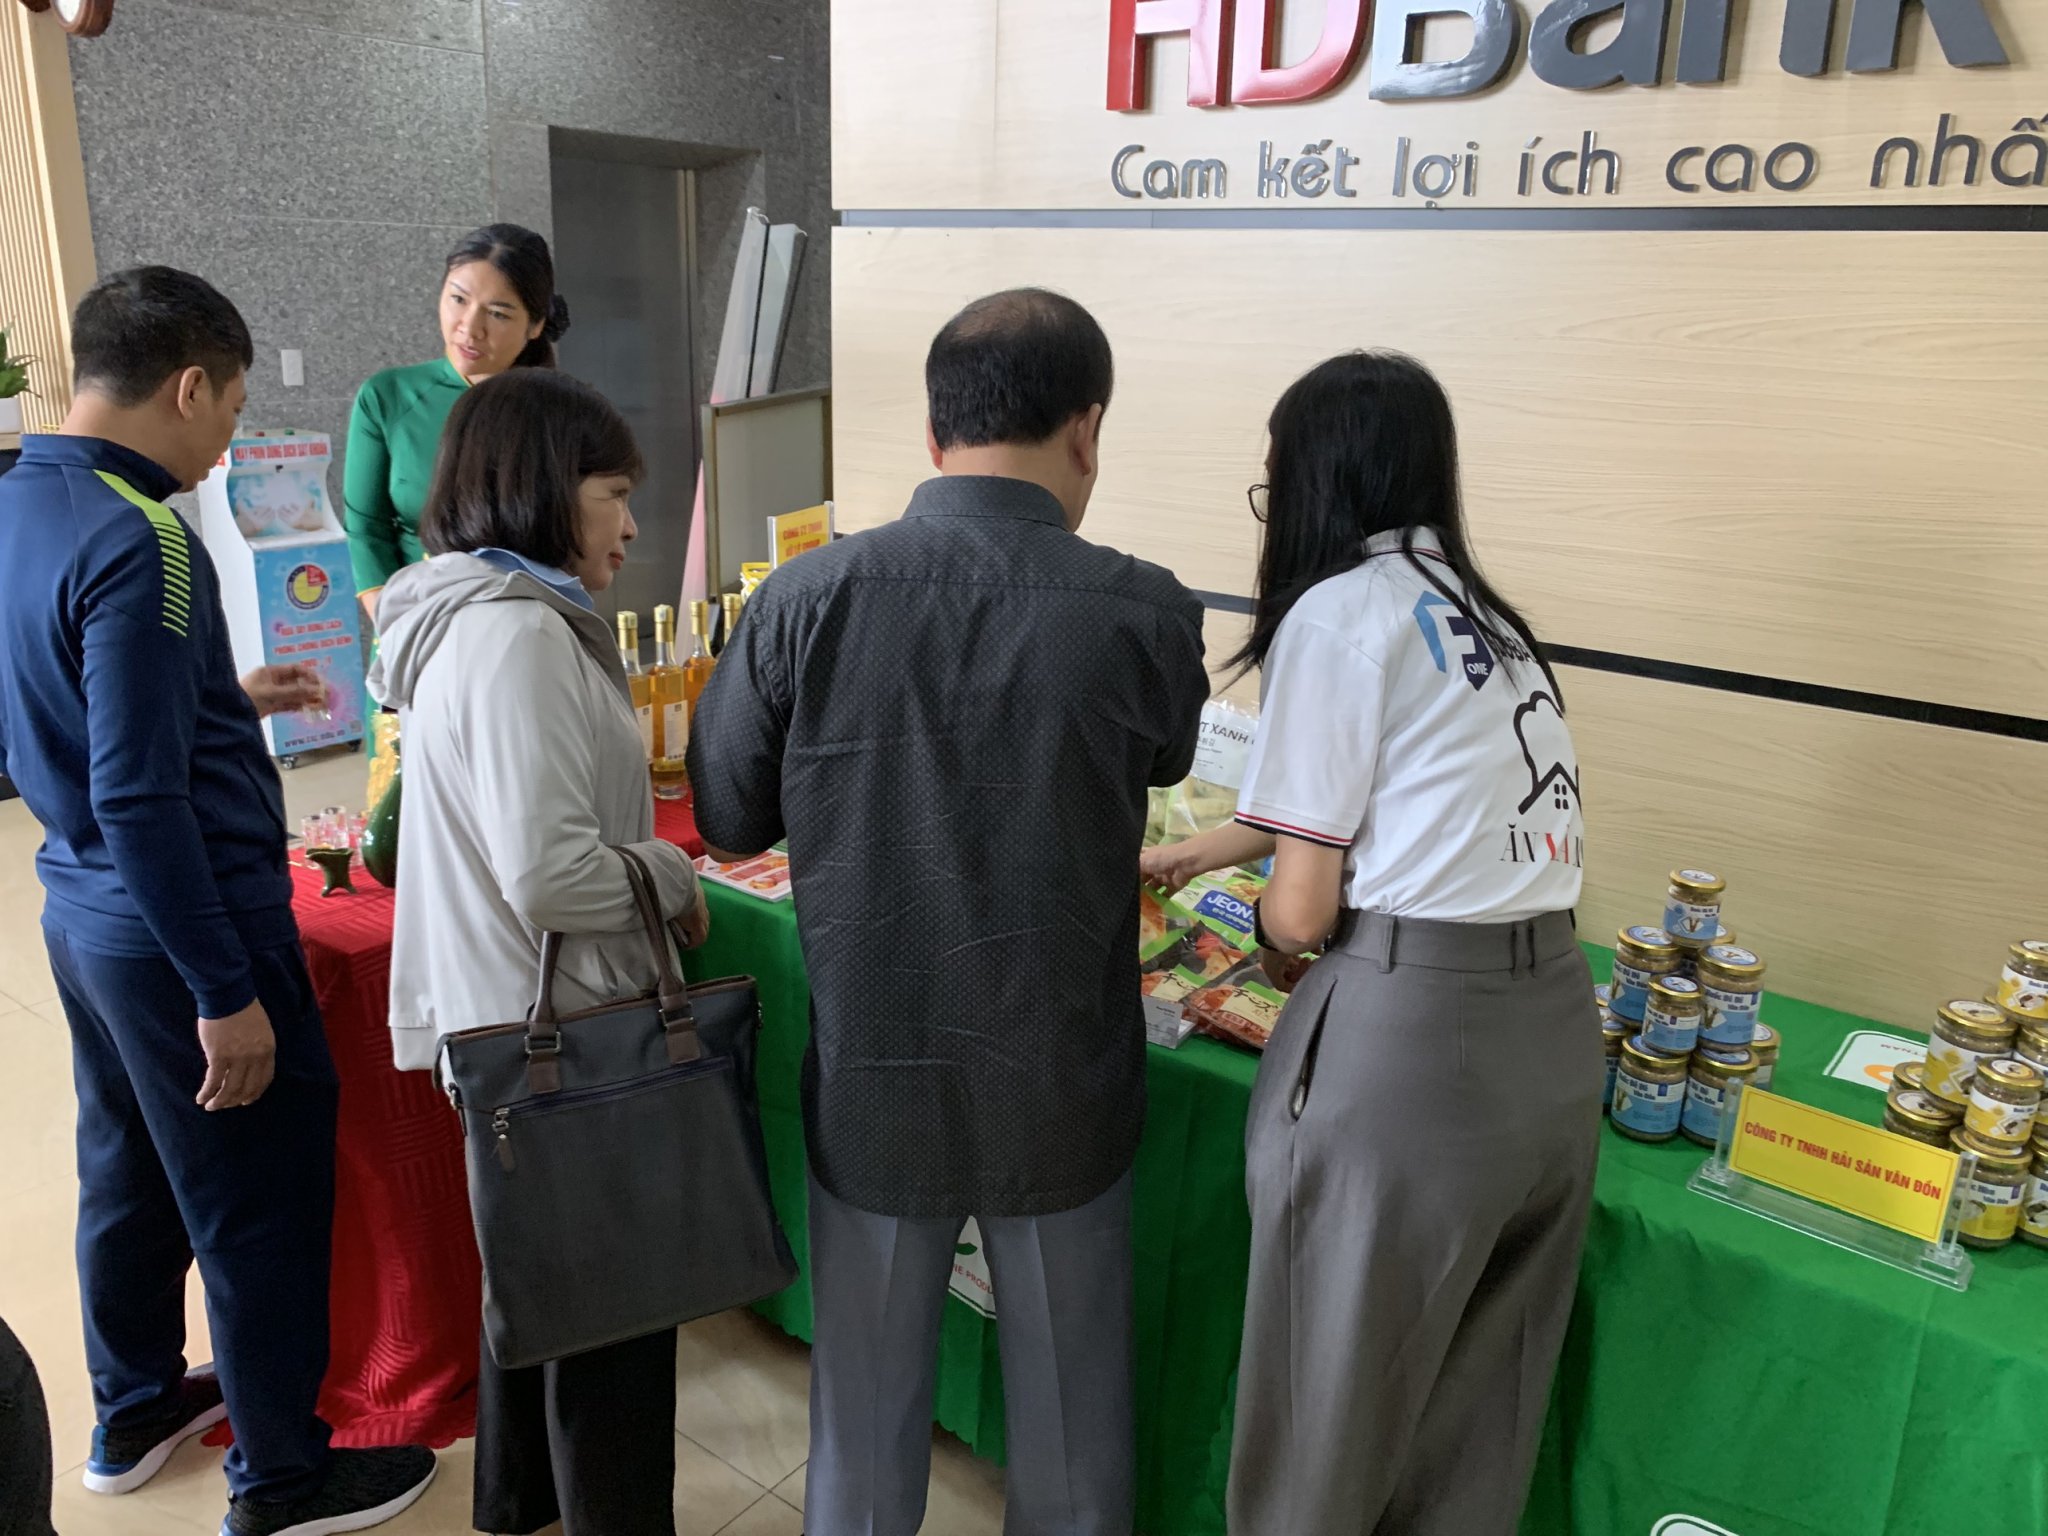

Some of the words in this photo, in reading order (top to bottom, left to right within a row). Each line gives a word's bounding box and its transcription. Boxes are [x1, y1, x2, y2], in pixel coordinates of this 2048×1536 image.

[1111, 144, 1228, 199] Cam
[1257, 138, 1359, 199] kết
[1393, 136, 1480, 209] lợi
[1517, 130, 1622, 195] ích
[1665, 141, 1819, 193] cao
[1869, 113, 2048, 188] nhấ
[1466, 662, 1489, 676] ONE
[1210, 723, 1249, 744] XANH
[1207, 894, 1254, 921] JEON
[1744, 1121, 1777, 1143] CÔNG
[1780, 1133, 1795, 1148] TY
[1797, 1139, 1829, 1161] TNHH
[1831, 1150, 1853, 1169] HẢI
[1855, 1158, 1883, 1180] SẢN
[1885, 1168, 1911, 1190] VÂN
[966, 1270, 994, 1295] PRODU
